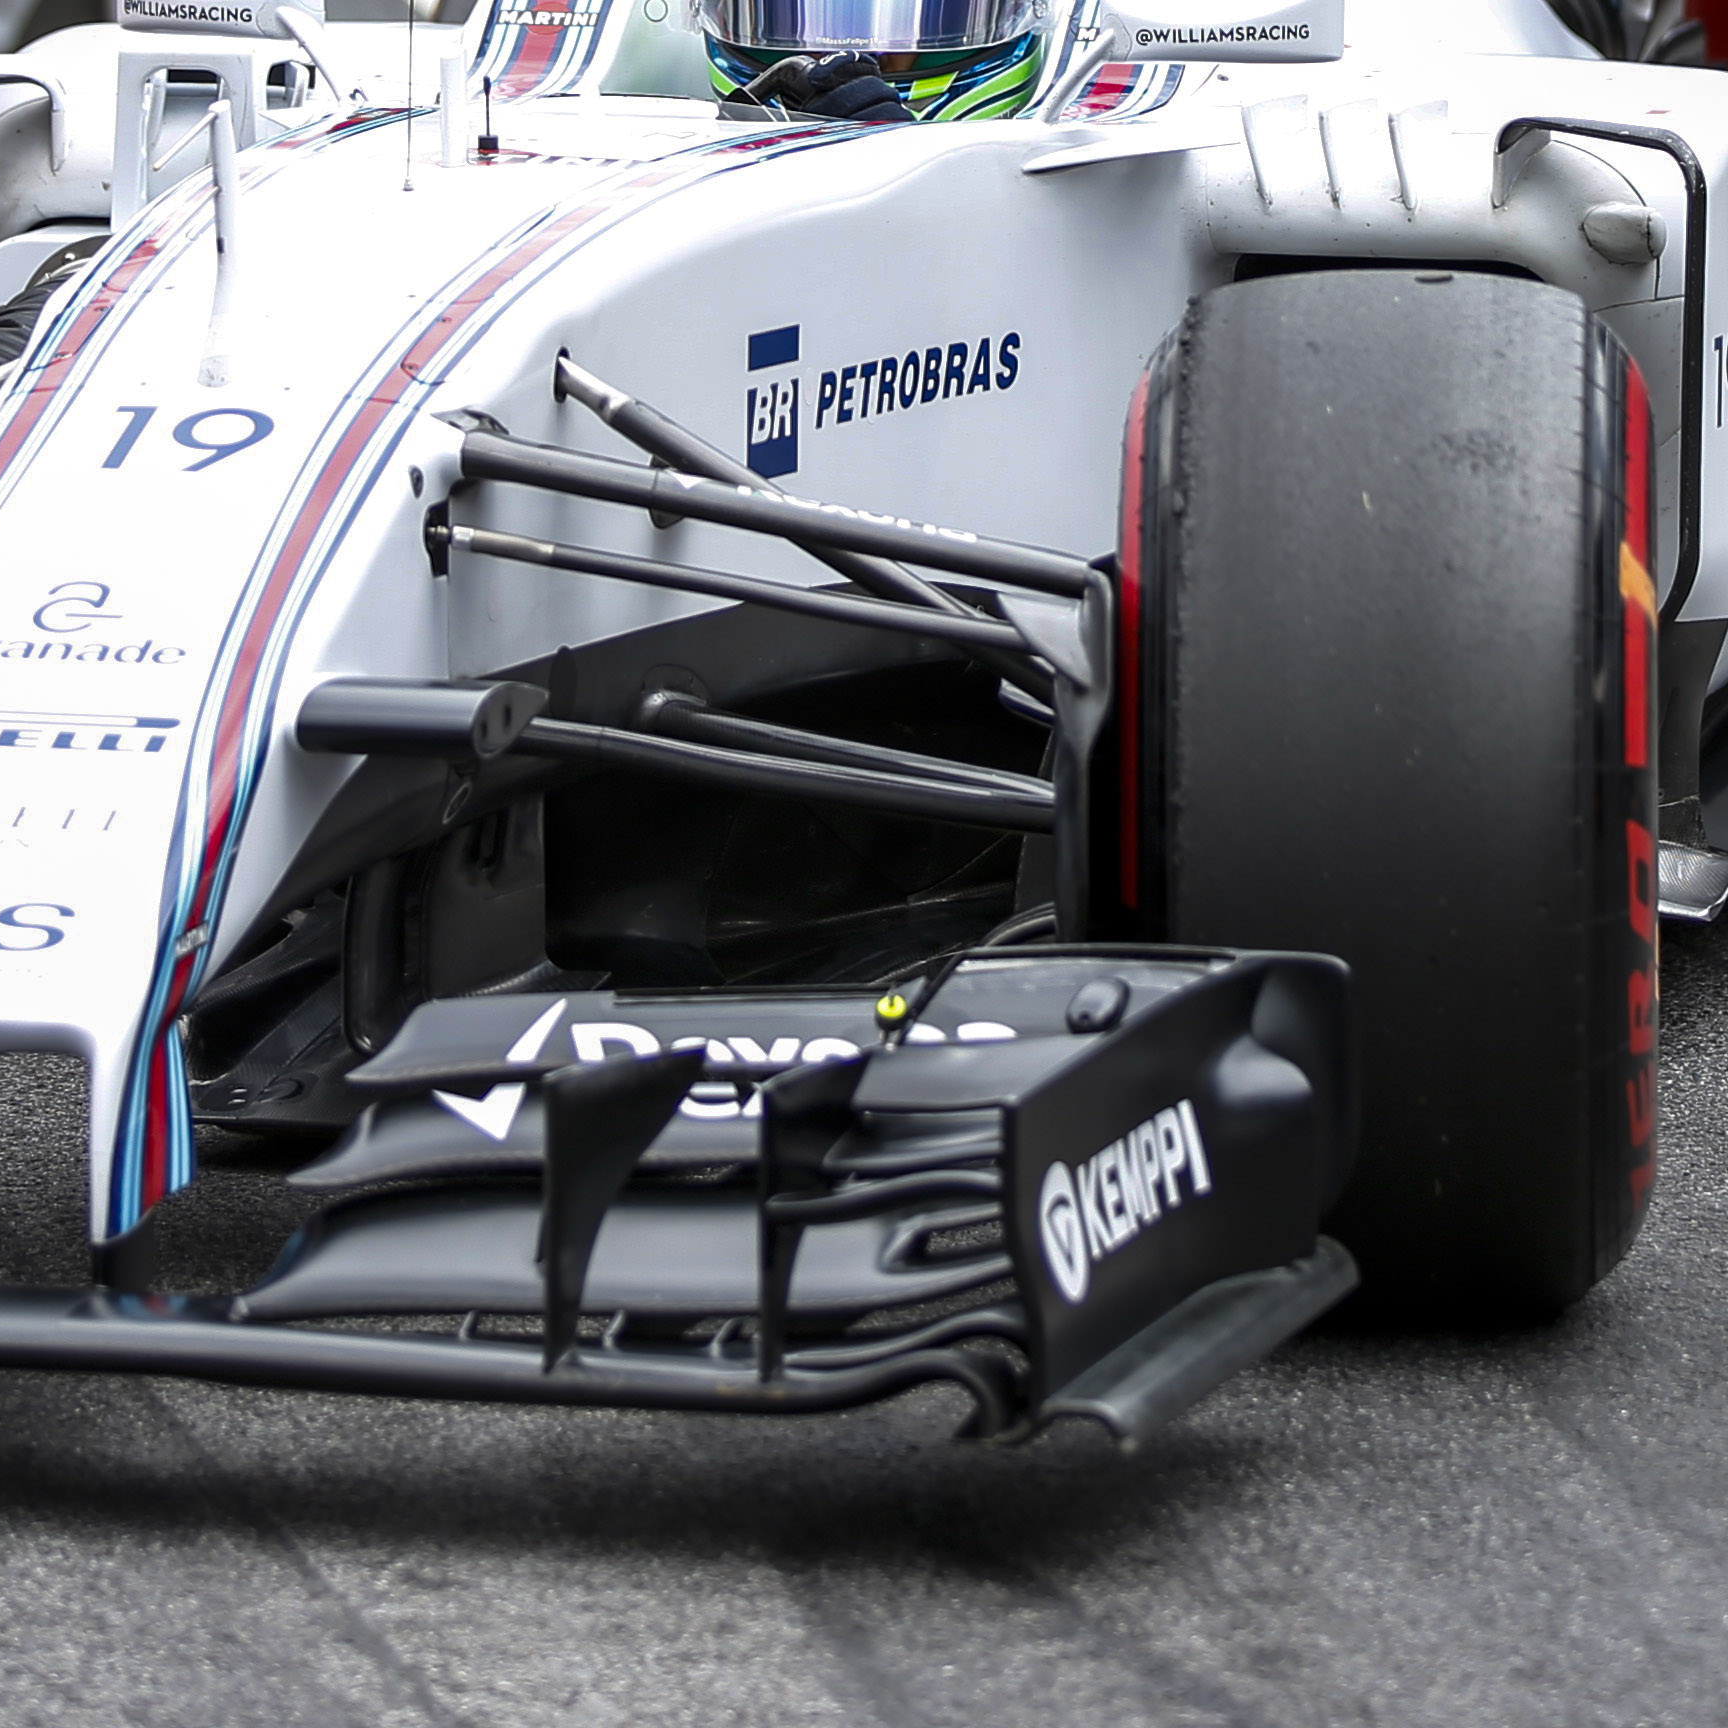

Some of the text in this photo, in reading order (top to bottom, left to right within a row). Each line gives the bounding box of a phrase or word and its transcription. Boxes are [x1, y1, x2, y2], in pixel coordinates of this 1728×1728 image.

[498, 8, 597, 28] MARTINI
[1135, 24, 1310, 47] @WILLIAMSRACING
[750, 377, 799, 446] BR
[814, 331, 1021, 430] PETROBRAS
[100, 405, 276, 472] 19
[1076, 1097, 1212, 1262] KEMPPI
